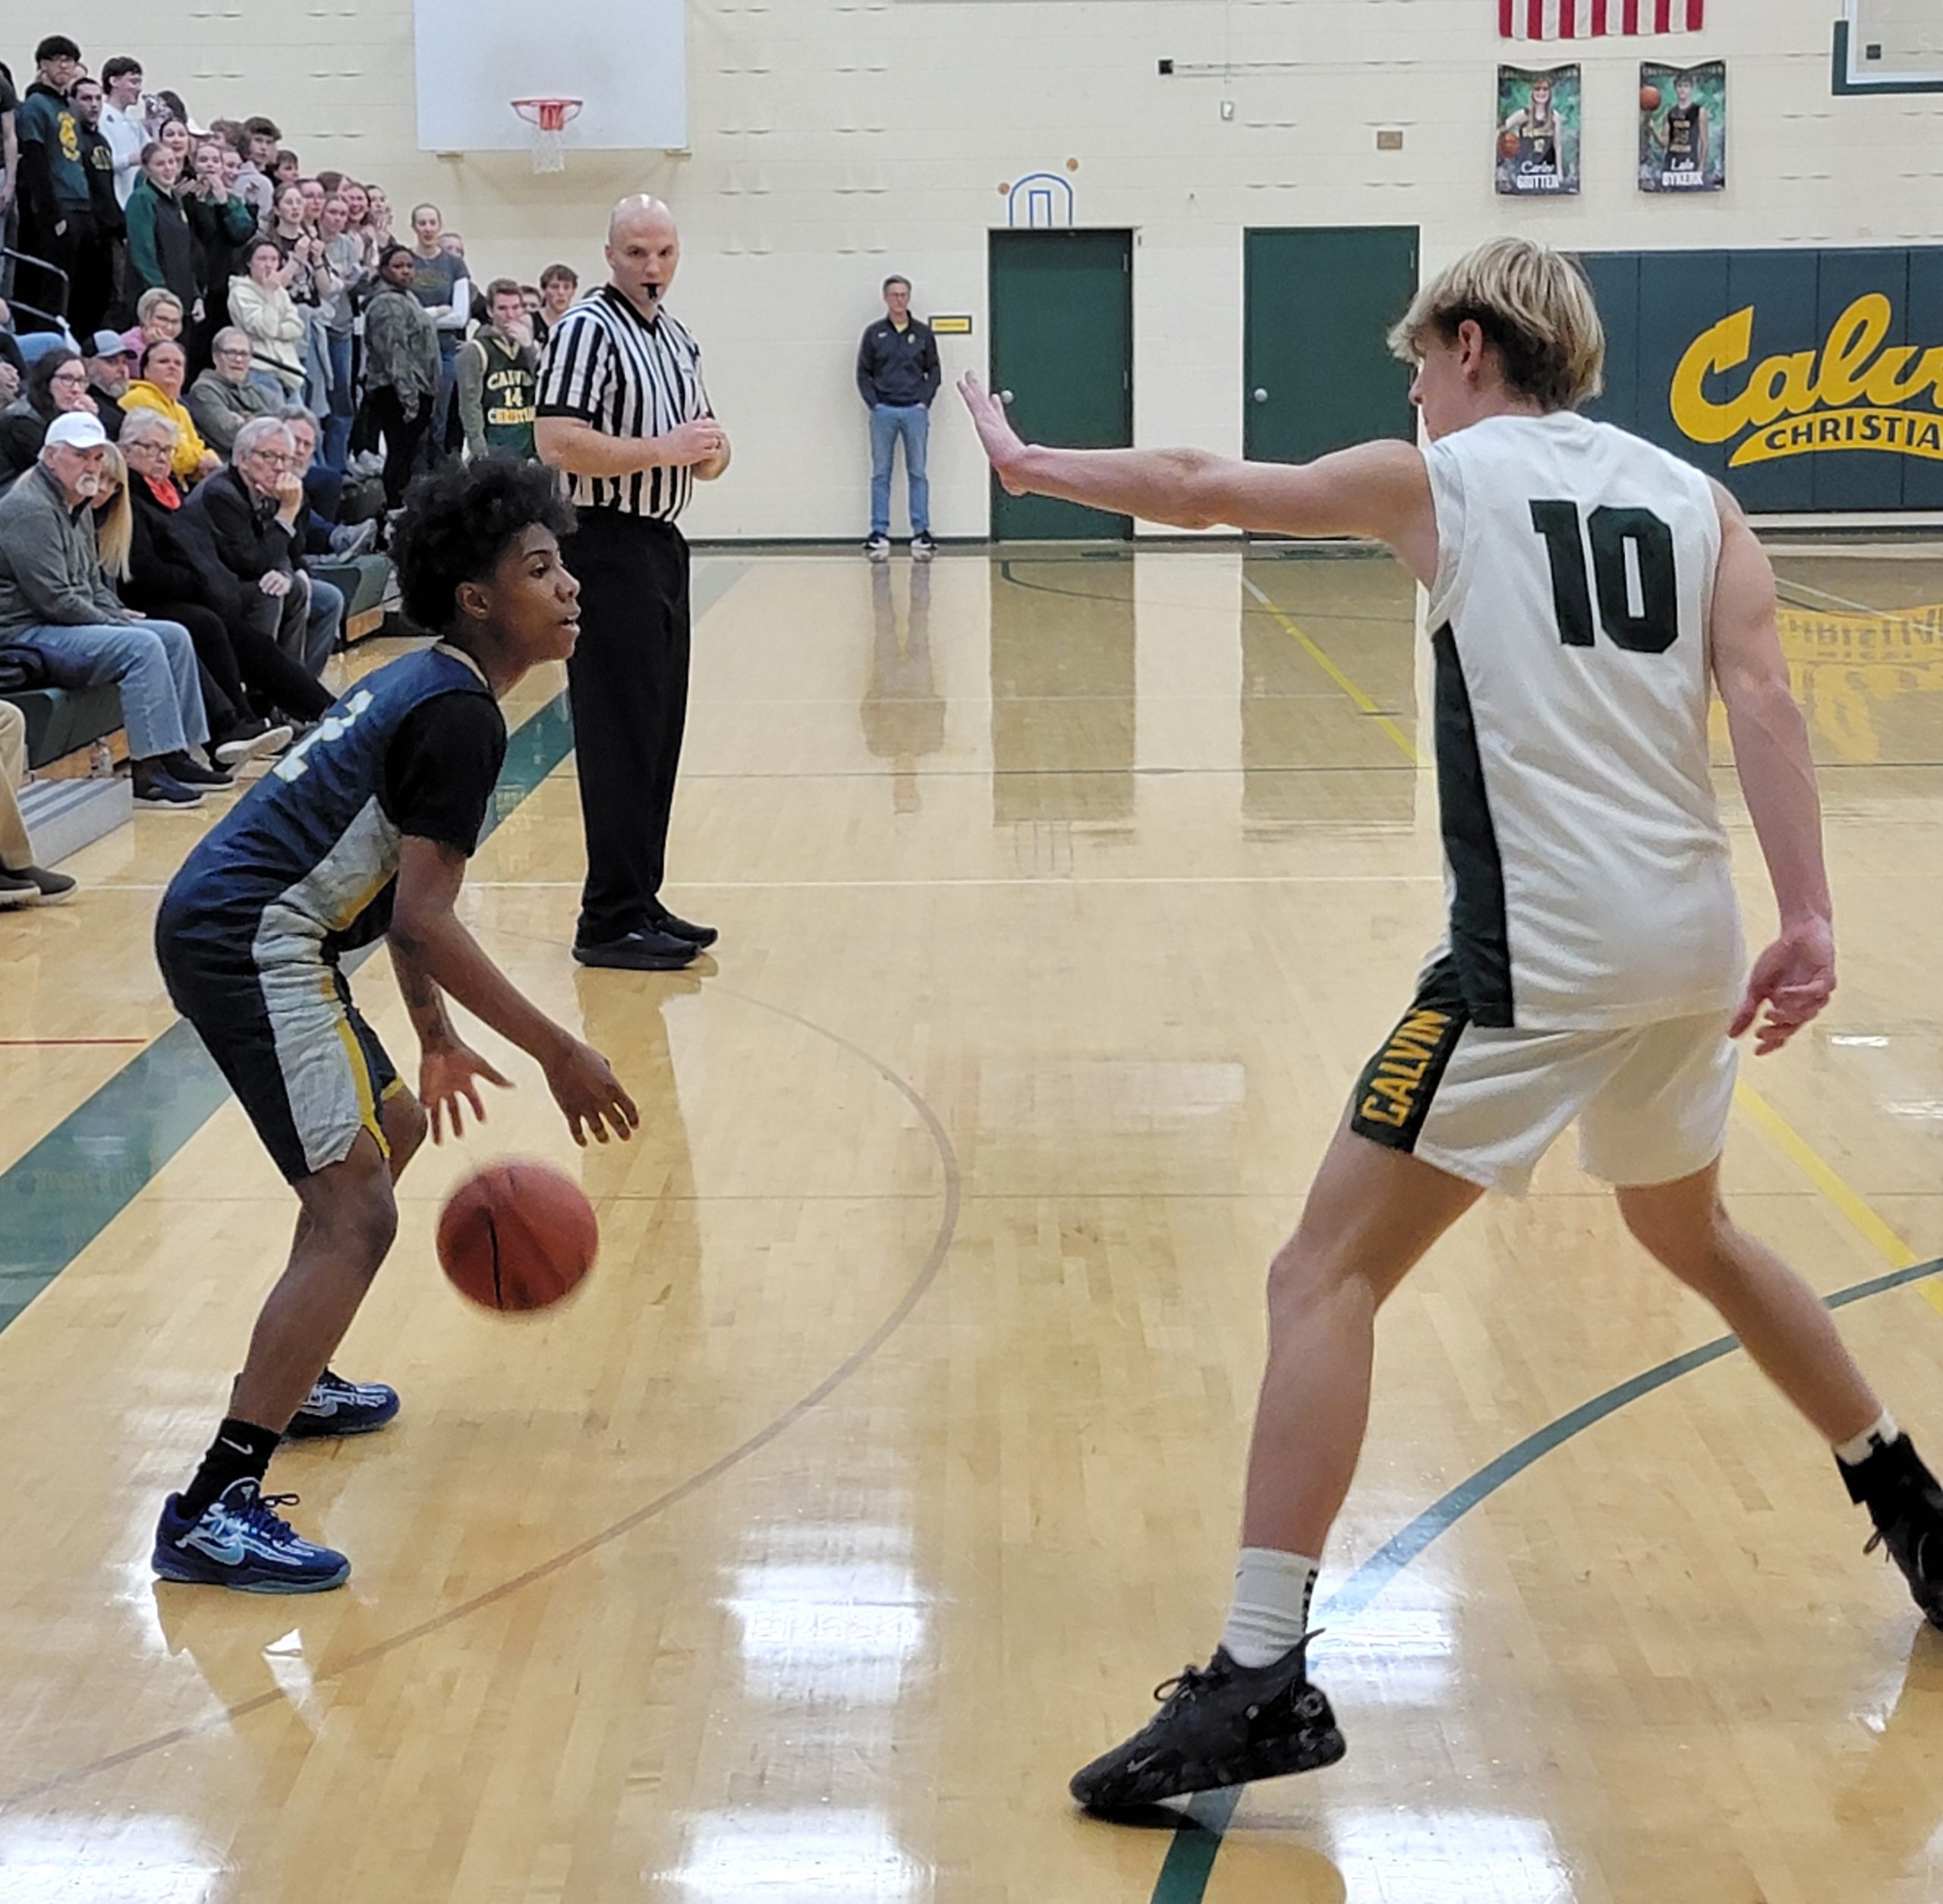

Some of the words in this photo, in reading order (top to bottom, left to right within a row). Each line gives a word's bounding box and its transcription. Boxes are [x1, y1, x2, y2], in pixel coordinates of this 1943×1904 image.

[1765, 414, 1943, 451] CHRISTIA
[1529, 499, 1678, 653] 10
[1360, 1009, 1451, 1127] CALVIN
